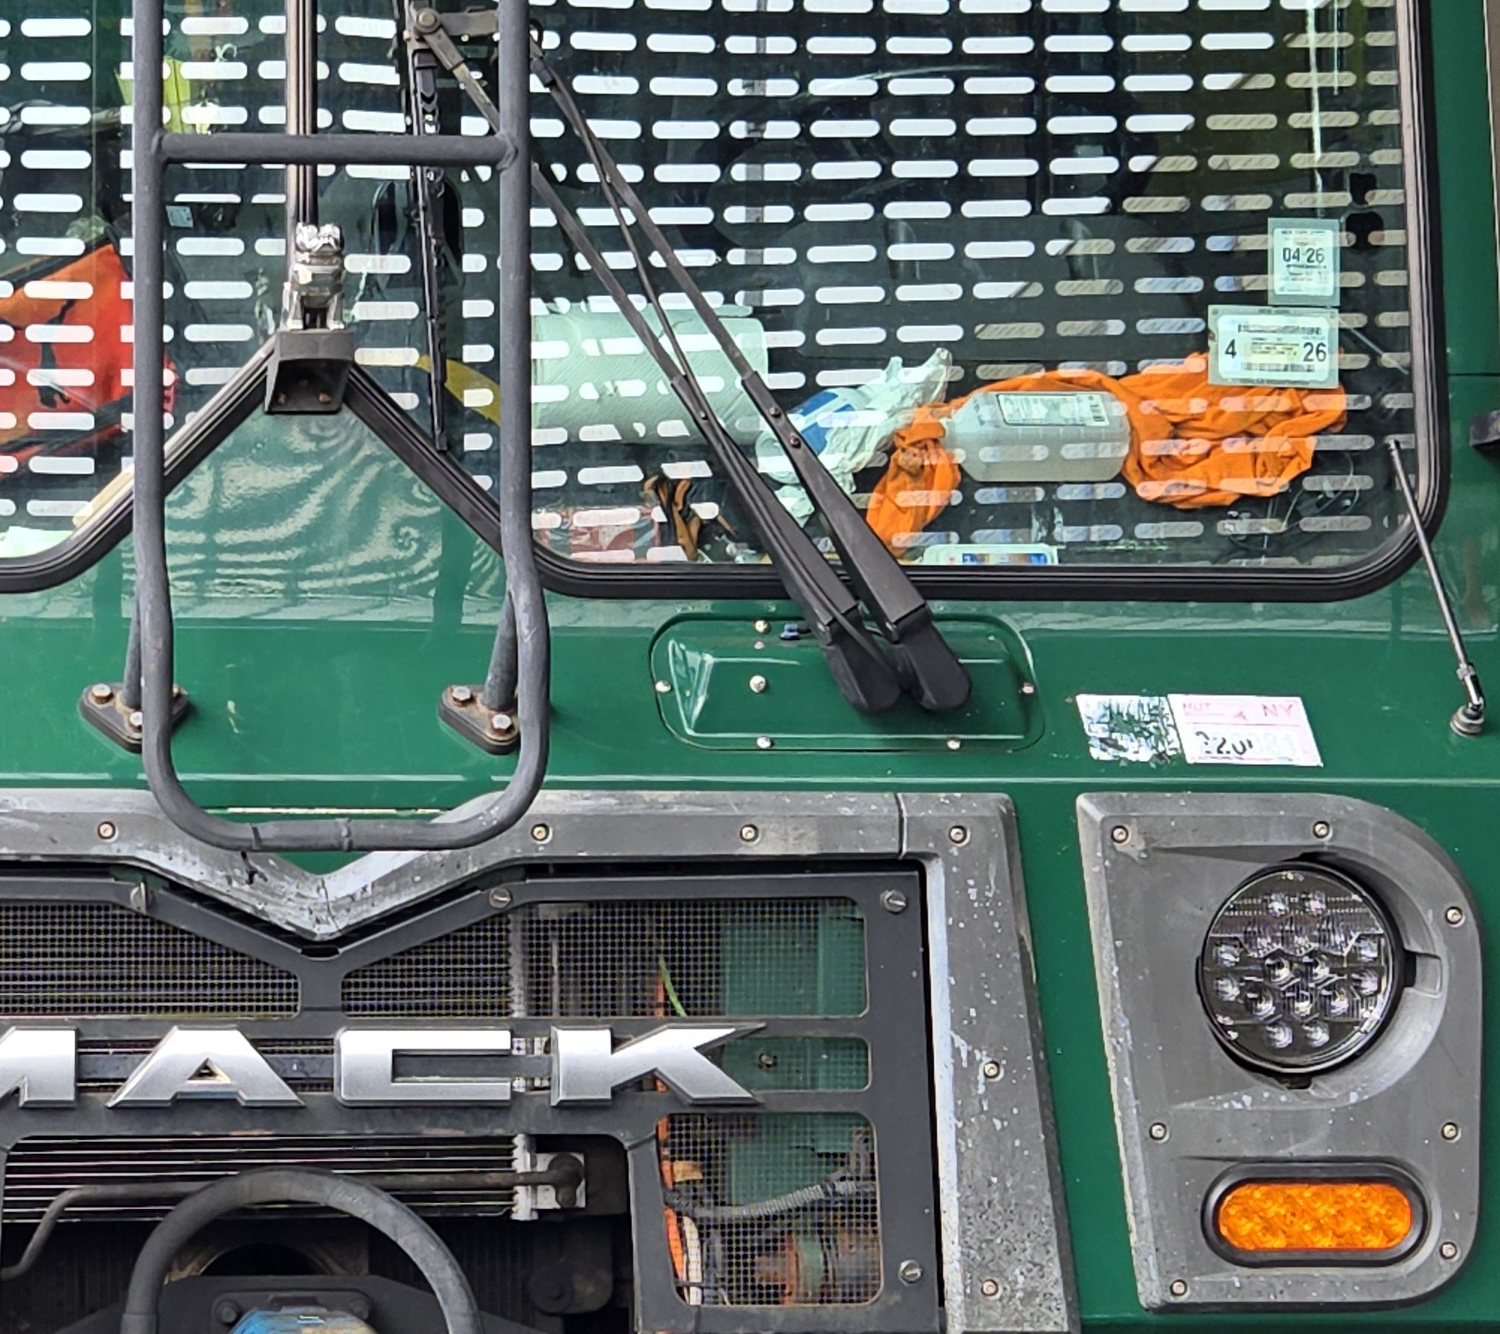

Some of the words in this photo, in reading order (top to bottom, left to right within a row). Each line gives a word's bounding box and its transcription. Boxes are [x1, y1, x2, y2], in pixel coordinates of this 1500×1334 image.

[1225, 339, 1237, 359] 4
[1303, 342, 1327, 362] 26
[1262, 703, 1293, 717] NY
